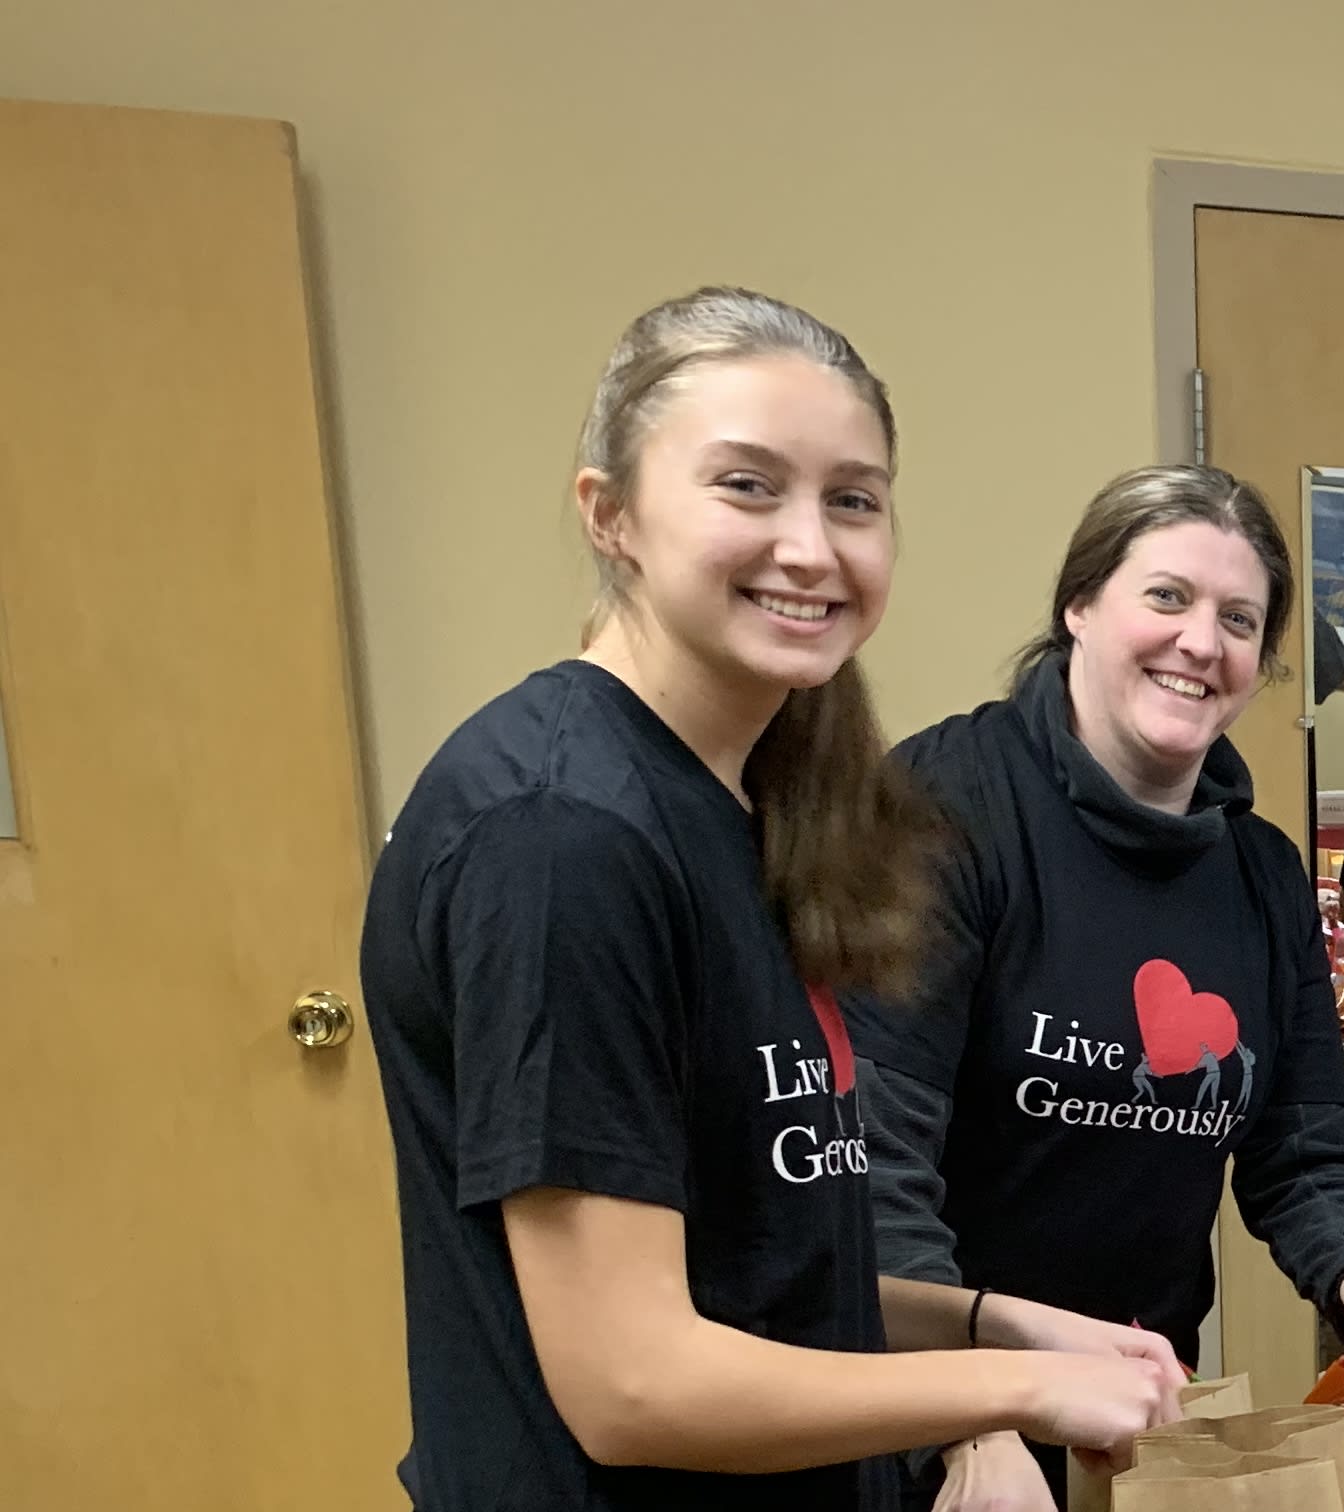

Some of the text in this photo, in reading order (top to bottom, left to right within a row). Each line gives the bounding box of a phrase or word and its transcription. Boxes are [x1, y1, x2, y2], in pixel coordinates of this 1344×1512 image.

[757, 1039, 829, 1103] Live
[1024, 1011, 1125, 1071] Live
[1016, 1076, 1245, 1148] Generously
